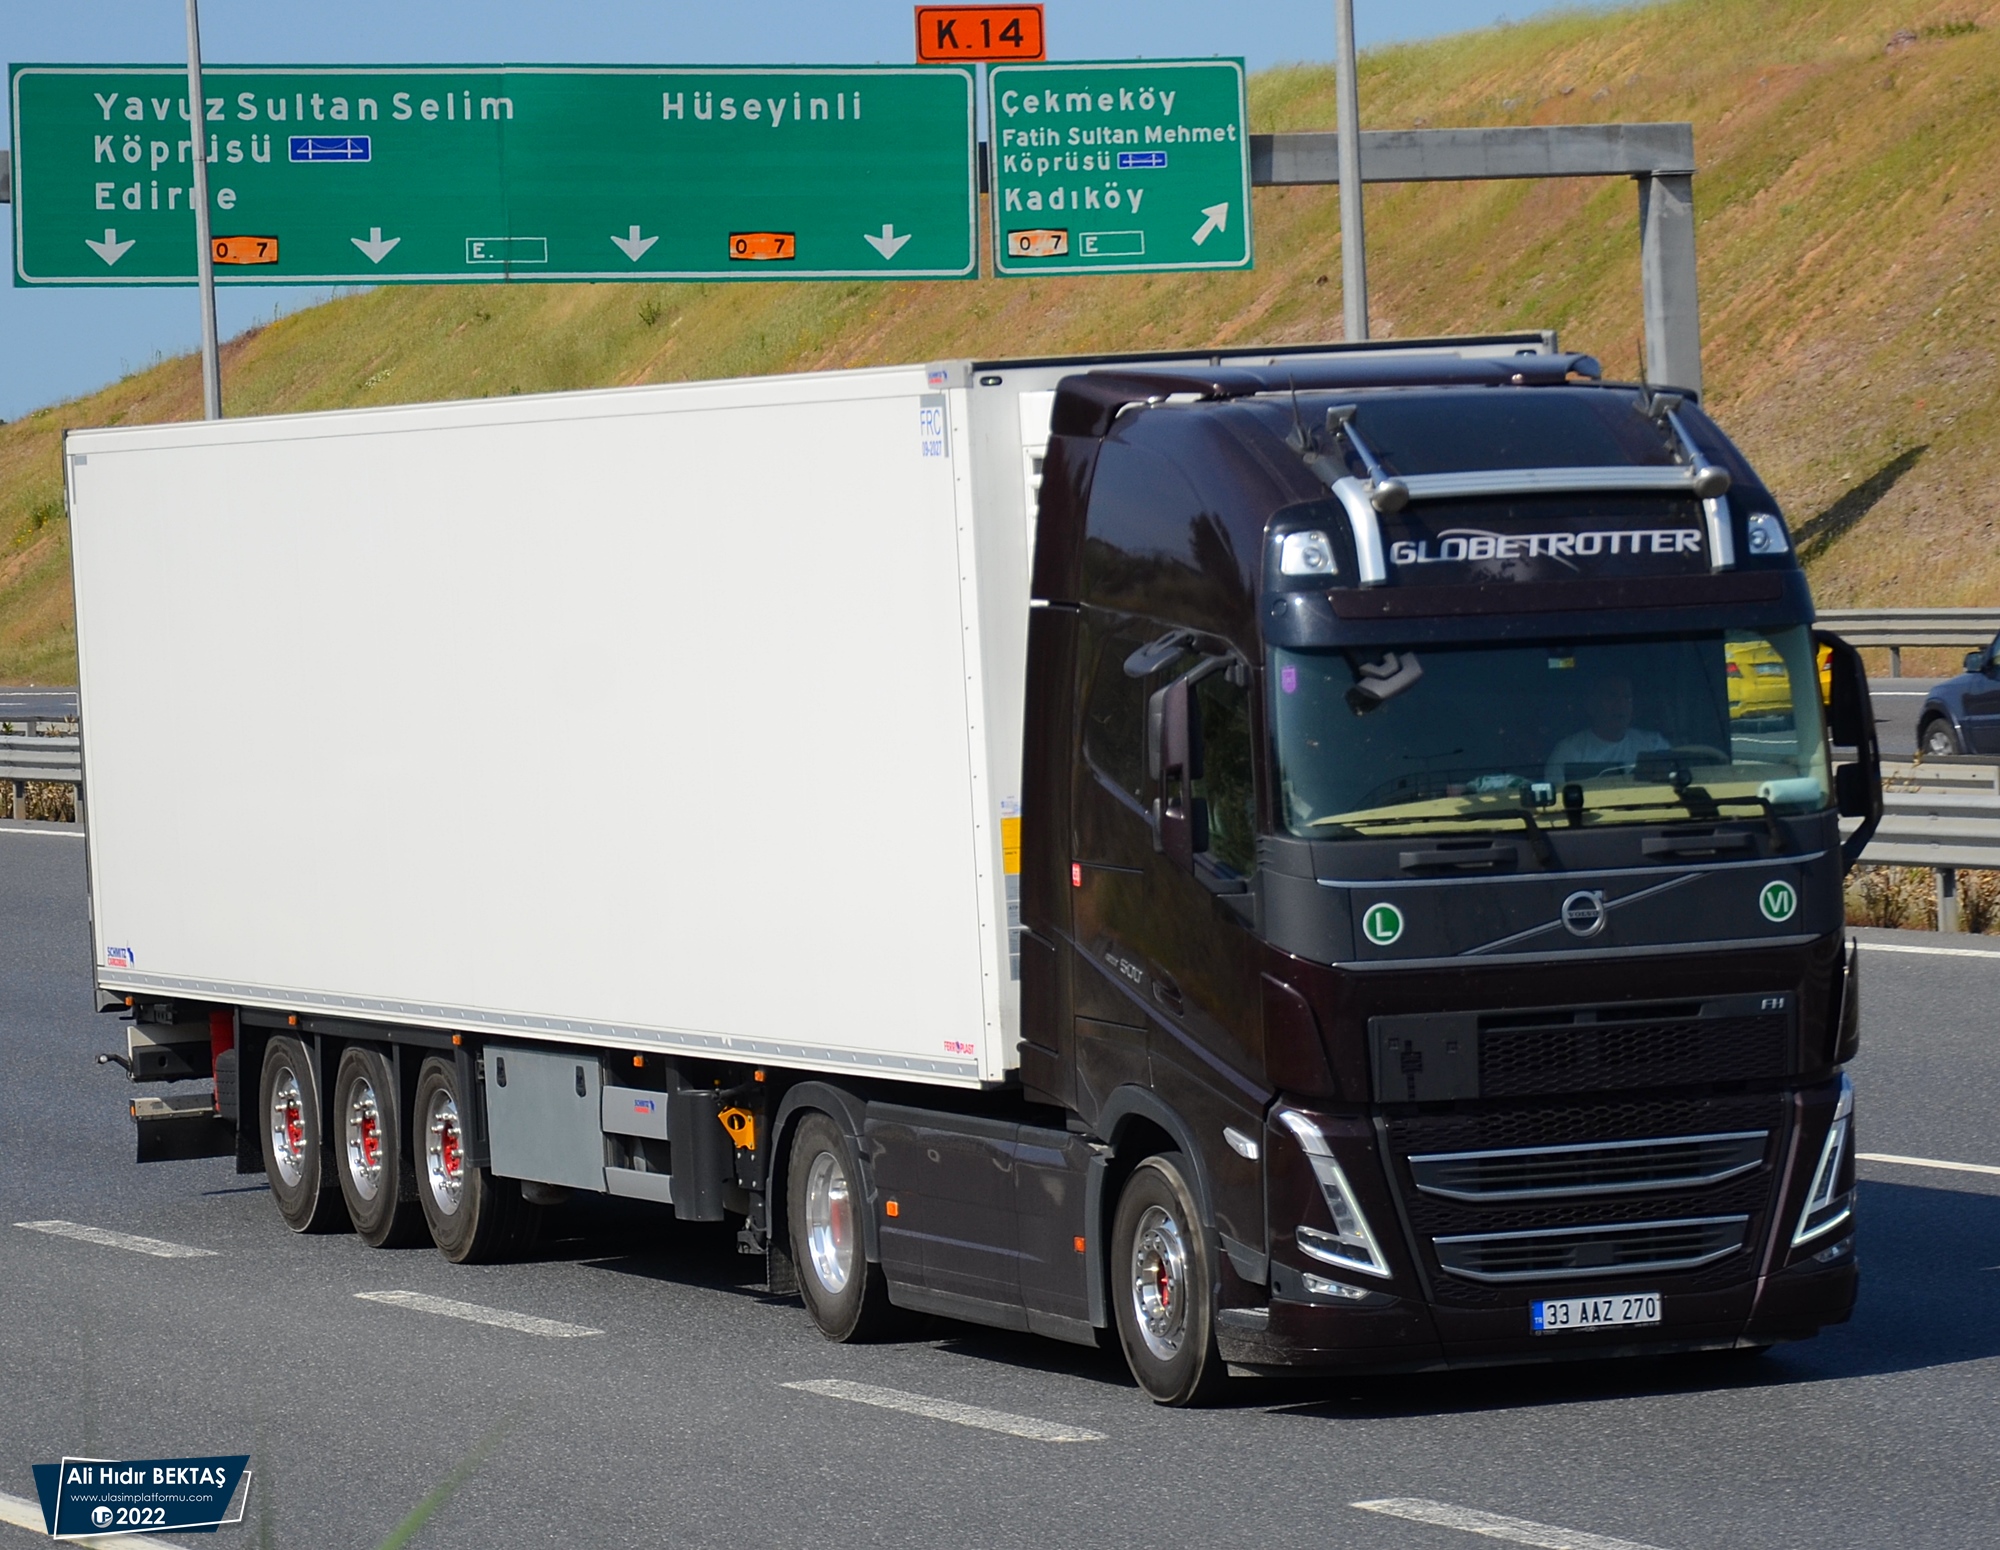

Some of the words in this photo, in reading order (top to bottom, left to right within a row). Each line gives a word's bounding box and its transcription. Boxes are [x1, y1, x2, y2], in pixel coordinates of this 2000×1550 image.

[937, 18, 1024, 49] K.14
[94, 93, 225, 121] Yavuz
[237, 92, 378, 121] Sultan
[392, 90, 513, 121] Selim
[662, 91, 861, 127] Hüseyinli
[1001, 87, 1176, 117] Çekmeköy
[1003, 127, 1060, 147] Fatih
[1067, 126, 1139, 145] Sultan
[1144, 124, 1237, 144] Mehmet
[1003, 151, 1111, 177] Köprüsü
[1005, 182, 1144, 214] Kadıköy
[256, 242, 268, 257] 7
[774, 239, 785, 253] 7
[1051, 235, 1062, 249] 7
[1085, 236, 1098, 252] E
[920, 409, 941, 436] FRC
[1390, 528, 1702, 566] GLOBETROTTER
[1568, 910, 1600, 918] VOLVO
[1766, 890, 1789, 913] VI
[1375, 911, 1393, 937] L
[1120, 958, 1143, 984] 500
[1761, 998, 1785, 1010] FH
[1547, 1303, 1570, 1325] 33
[1580, 1300, 1613, 1323] AAZ
[1622, 1297, 1656, 1320] 270
